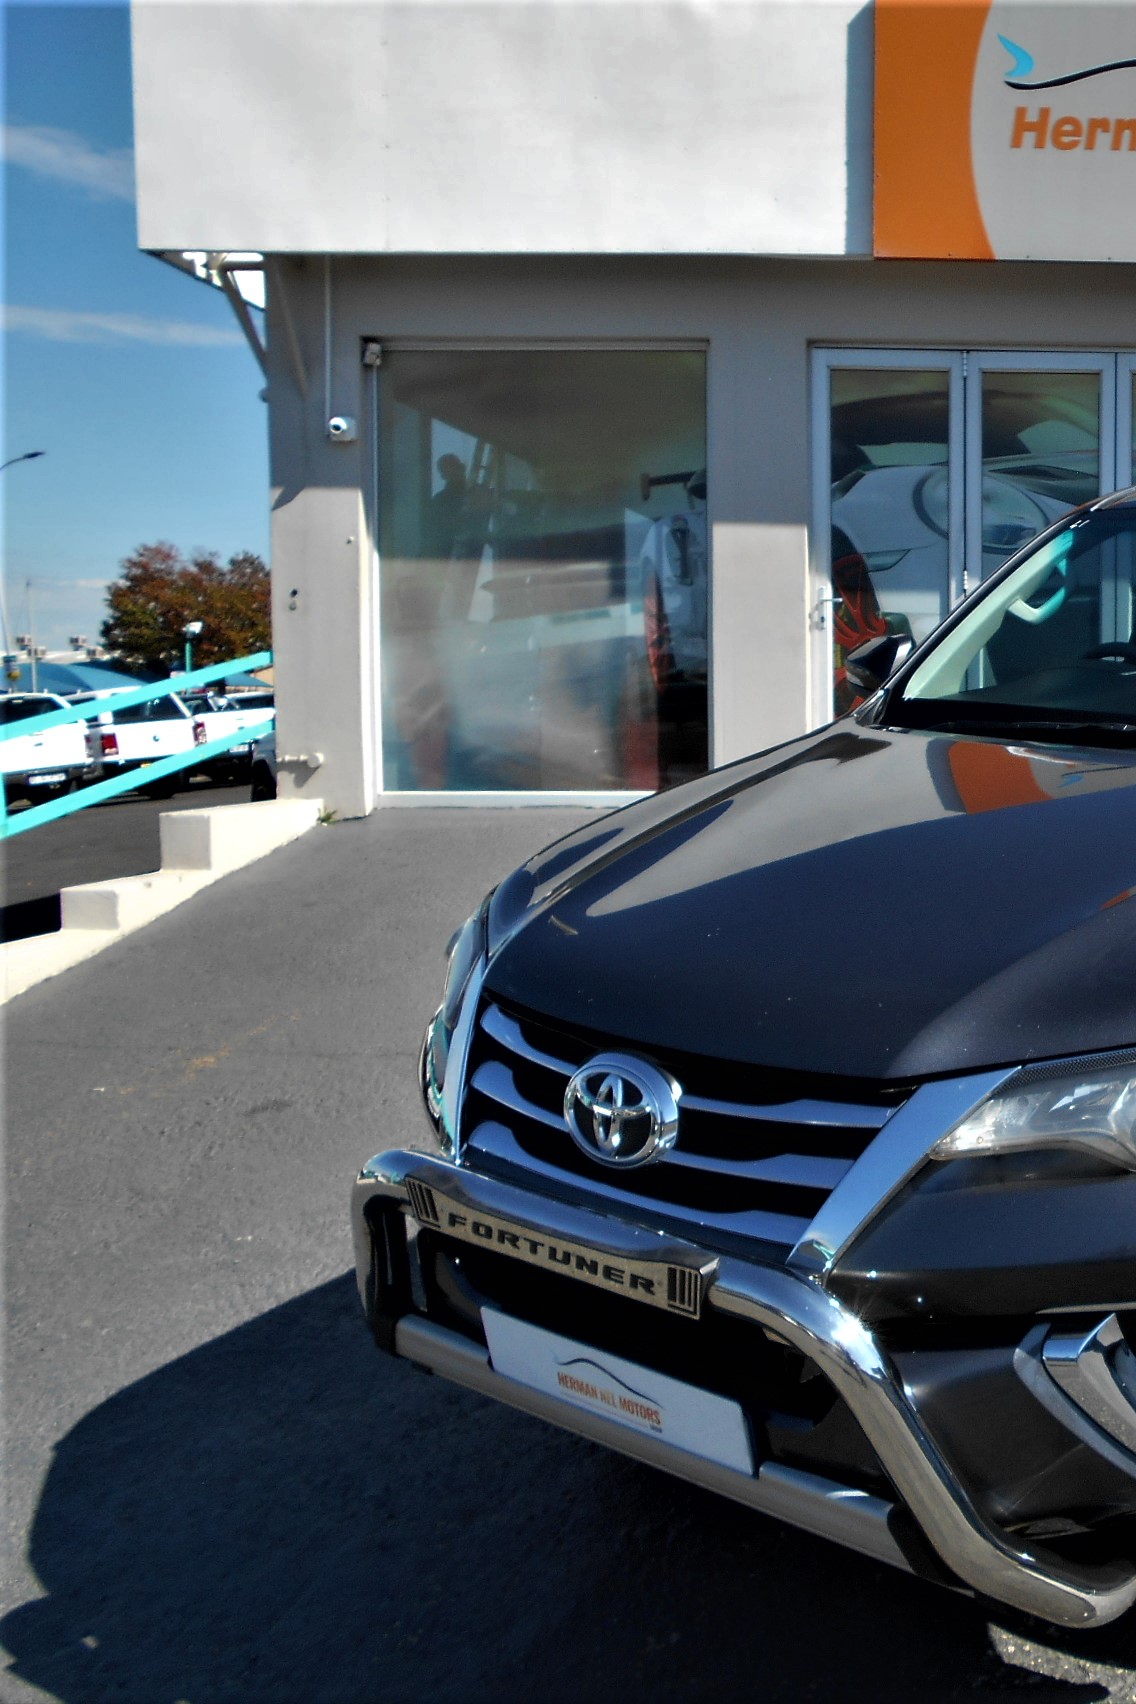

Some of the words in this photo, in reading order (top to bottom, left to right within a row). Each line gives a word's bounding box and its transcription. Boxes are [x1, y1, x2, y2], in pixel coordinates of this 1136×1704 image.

[447, 1211, 657, 1296] FORTUNER
[557, 1371, 599, 1399] HERMAN
[619, 1395, 662, 1425] MOTORS
